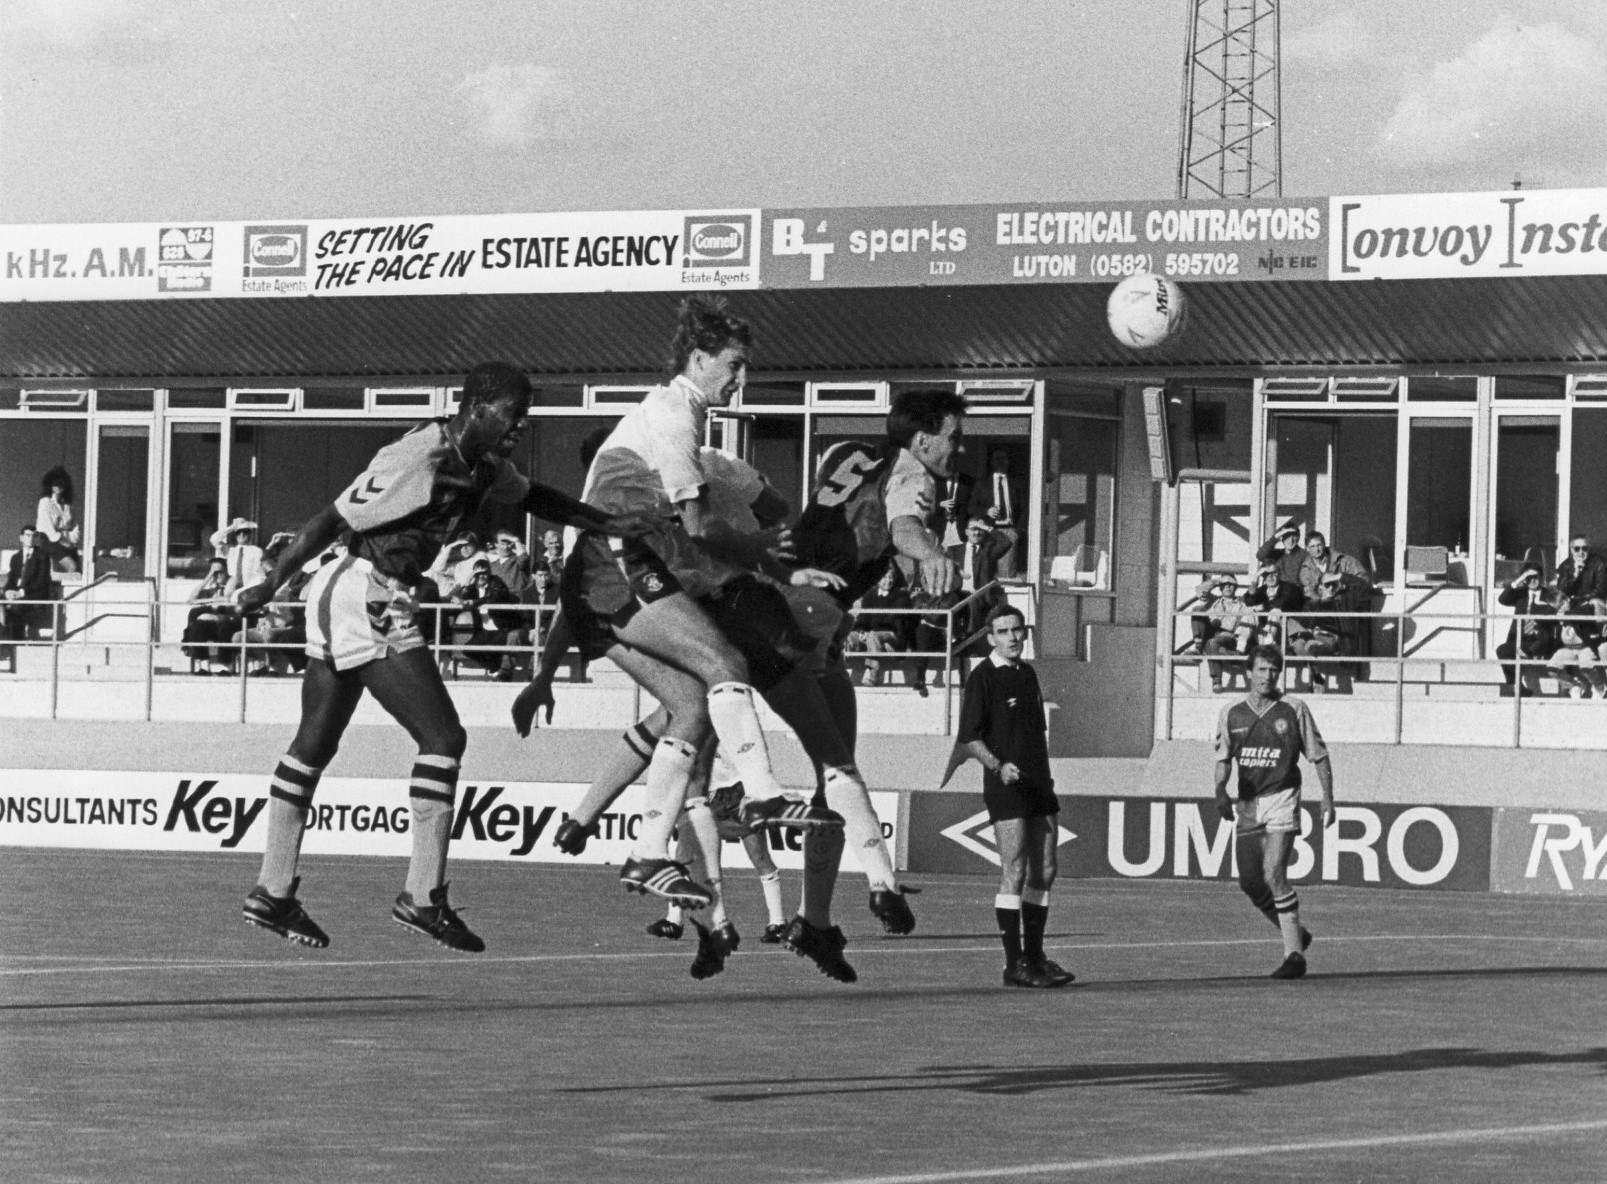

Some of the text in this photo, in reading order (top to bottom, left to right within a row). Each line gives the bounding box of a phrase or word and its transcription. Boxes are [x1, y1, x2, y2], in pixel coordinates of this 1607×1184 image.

[315, 223, 433, 259] SETTING
[695, 232, 738, 249] Connell
[850, 220, 967, 261] sparks
[996, 207, 1320, 245] ELECTRICAL CONTRACTORS
[315, 250, 476, 290] THE PACE IN
[482, 235, 679, 269] ESTATE AGENCY
[930, 261, 956, 275] LTD
[1013, 253, 1239, 277] LUTON (0582) 595702
[242, 279, 308, 293] Estate Agents
[682, 270, 751, 286] Estate Agents
[817, 450, 884, 507] 5
[163, 780, 268, 847] Key
[451, 787, 557, 856] Key
[1524, 813, 1607, 891] RY
